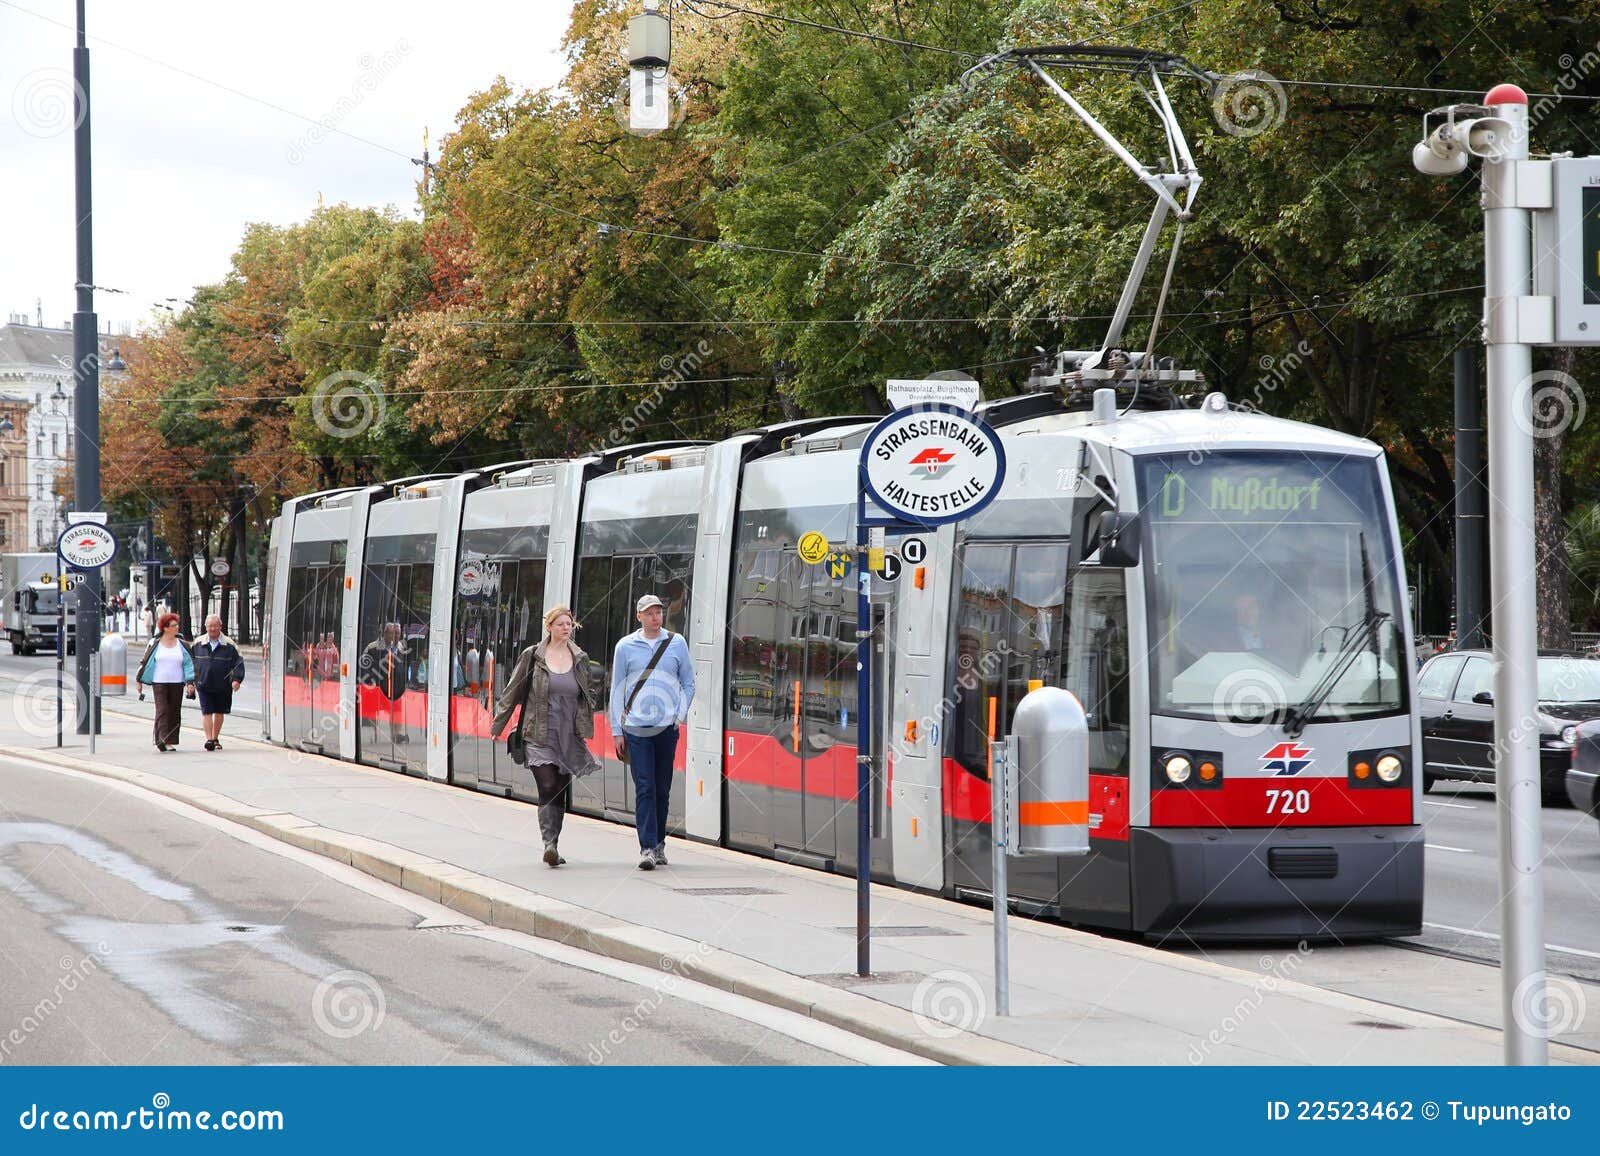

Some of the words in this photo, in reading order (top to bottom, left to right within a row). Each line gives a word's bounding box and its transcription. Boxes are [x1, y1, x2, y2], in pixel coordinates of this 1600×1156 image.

[876, 420, 988, 461] STRASSENBAHN
[882, 477, 986, 512] HALTESTELLE
[1162, 472, 1187, 517] D
[1211, 476, 1322, 515] Nußdorf
[64, 527, 110, 545] STRASSENBAHN
[67, 551, 109, 566] HALTESTELLE
[1264, 789, 1311, 815] 720
